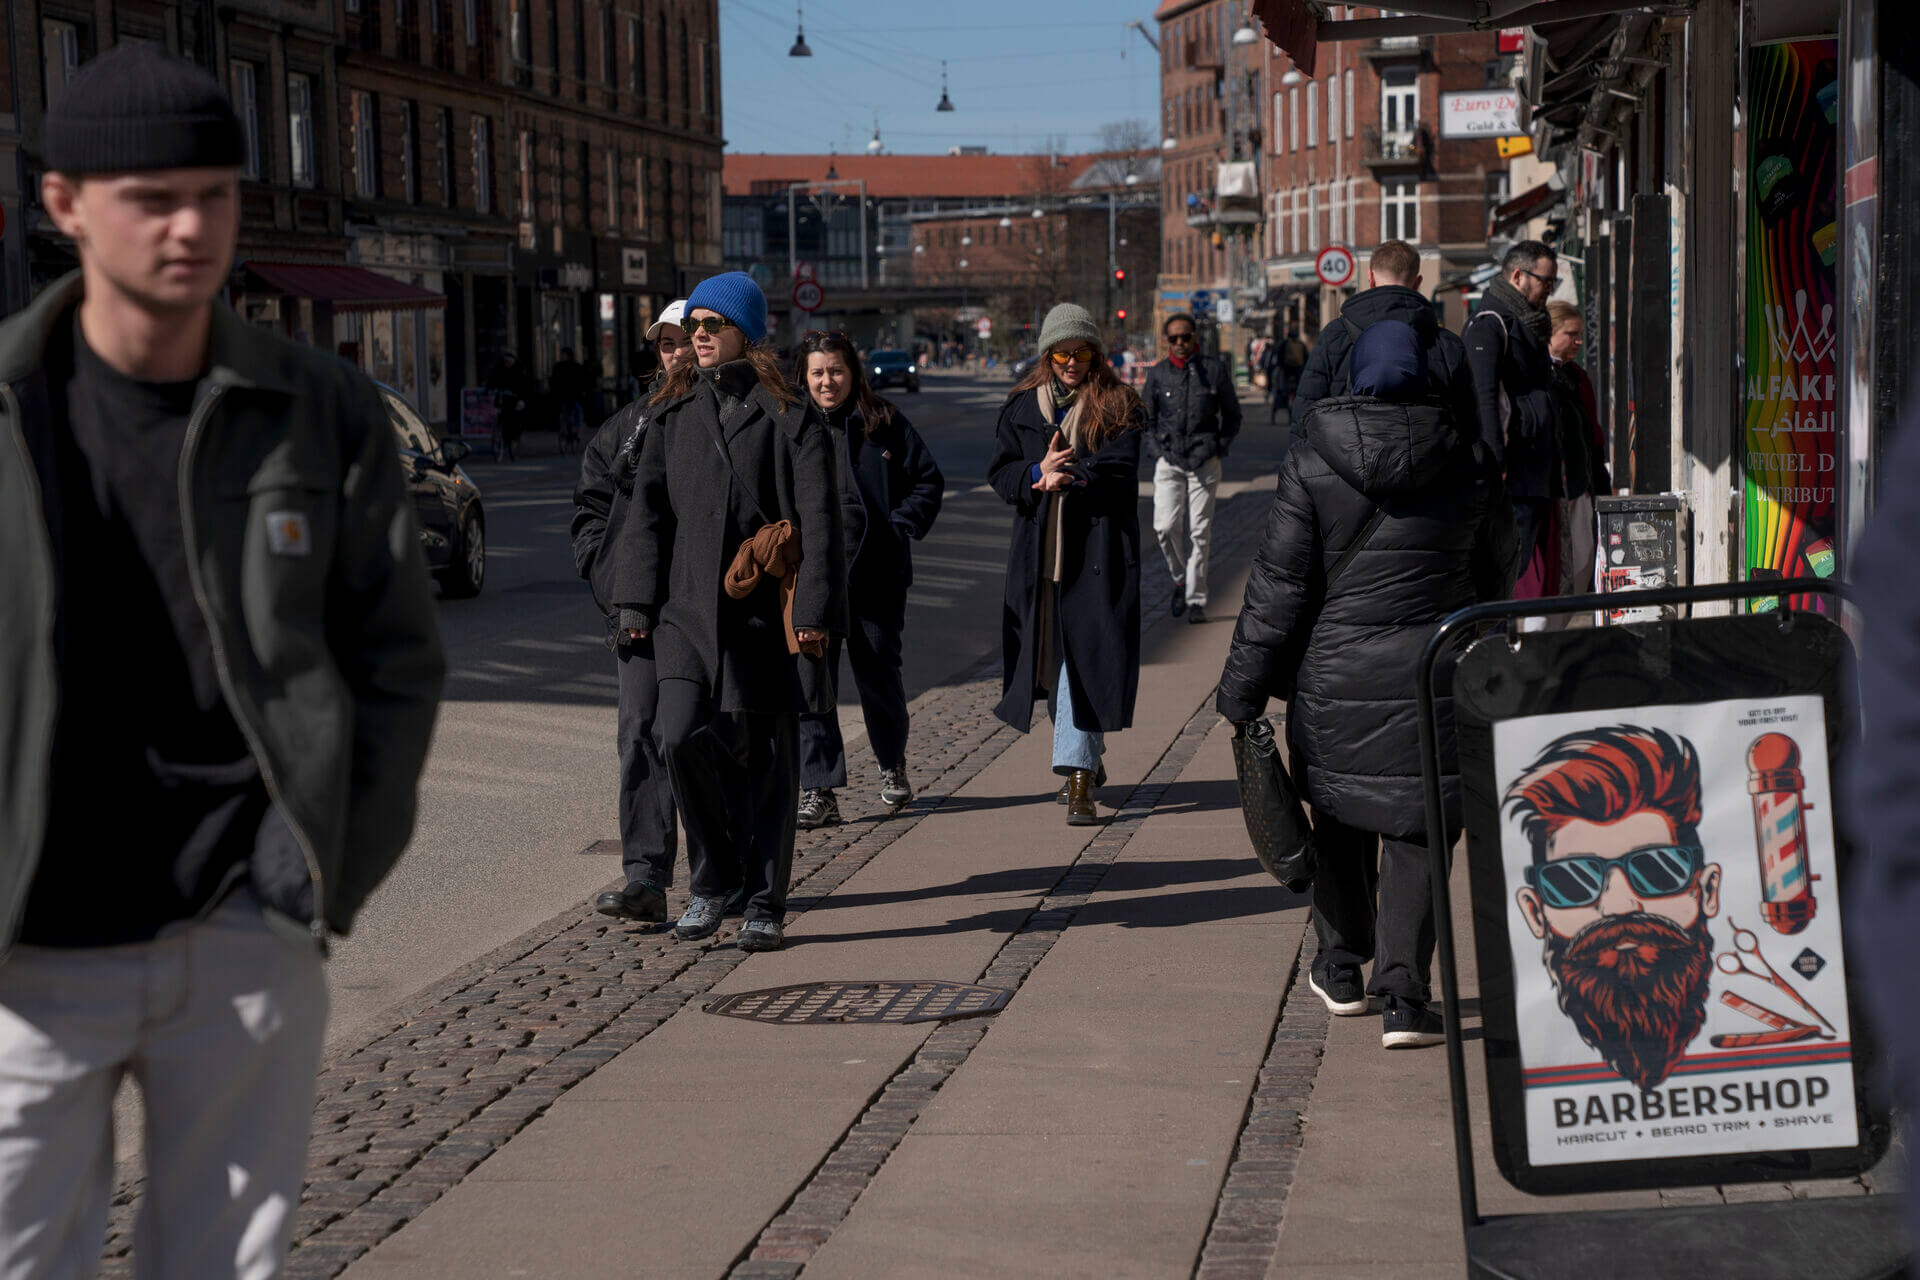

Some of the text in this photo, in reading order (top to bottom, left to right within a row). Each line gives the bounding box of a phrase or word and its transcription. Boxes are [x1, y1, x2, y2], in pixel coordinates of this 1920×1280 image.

[1451, 97, 1491, 112] Euro
[1323, 258, 1347, 274] 40
[1746, 452, 1812, 472] OFFICIEL
[1553, 1076, 1830, 1129] BARBERSHOP
[1557, 1114, 1834, 1146] HAIRCUT BEARD TRIM SHAVE
